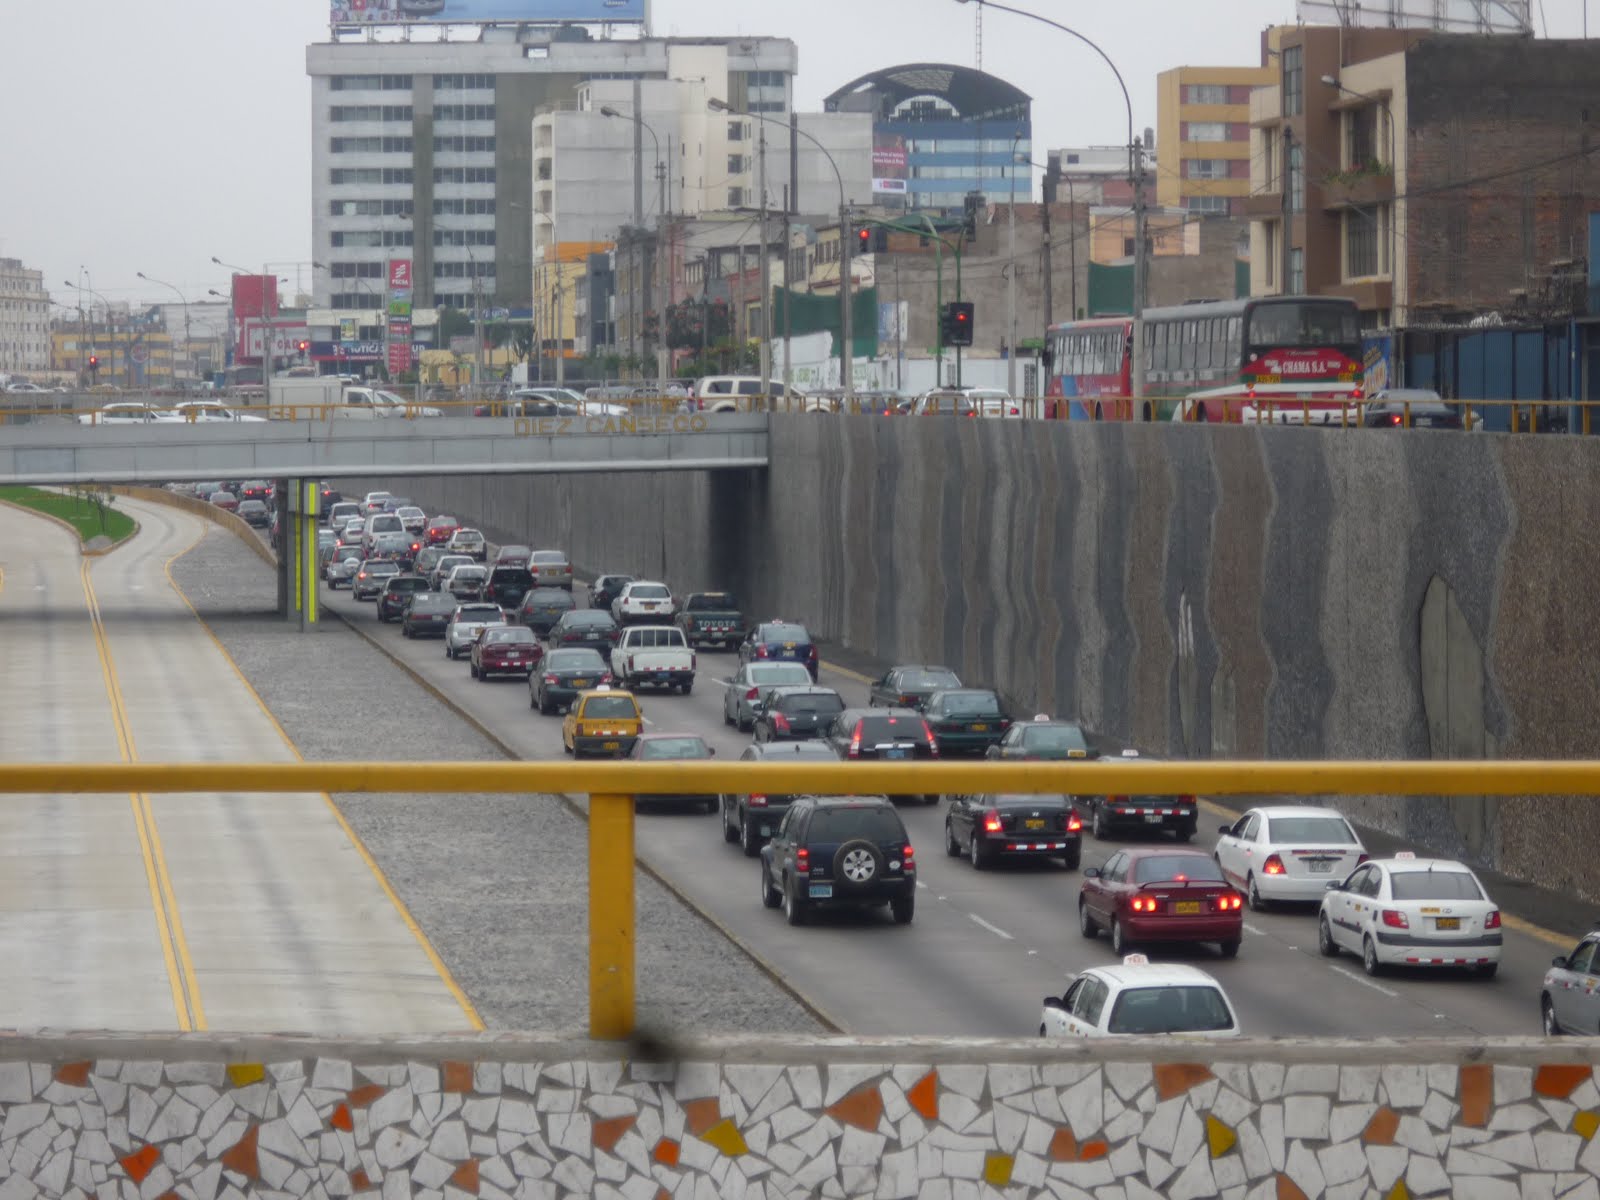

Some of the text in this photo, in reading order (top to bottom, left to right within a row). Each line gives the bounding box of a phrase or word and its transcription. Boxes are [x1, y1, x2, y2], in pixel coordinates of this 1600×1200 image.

[1283, 361, 1310, 374] CHAMA
[514, 415, 707, 436] DIEZ CANSECO
